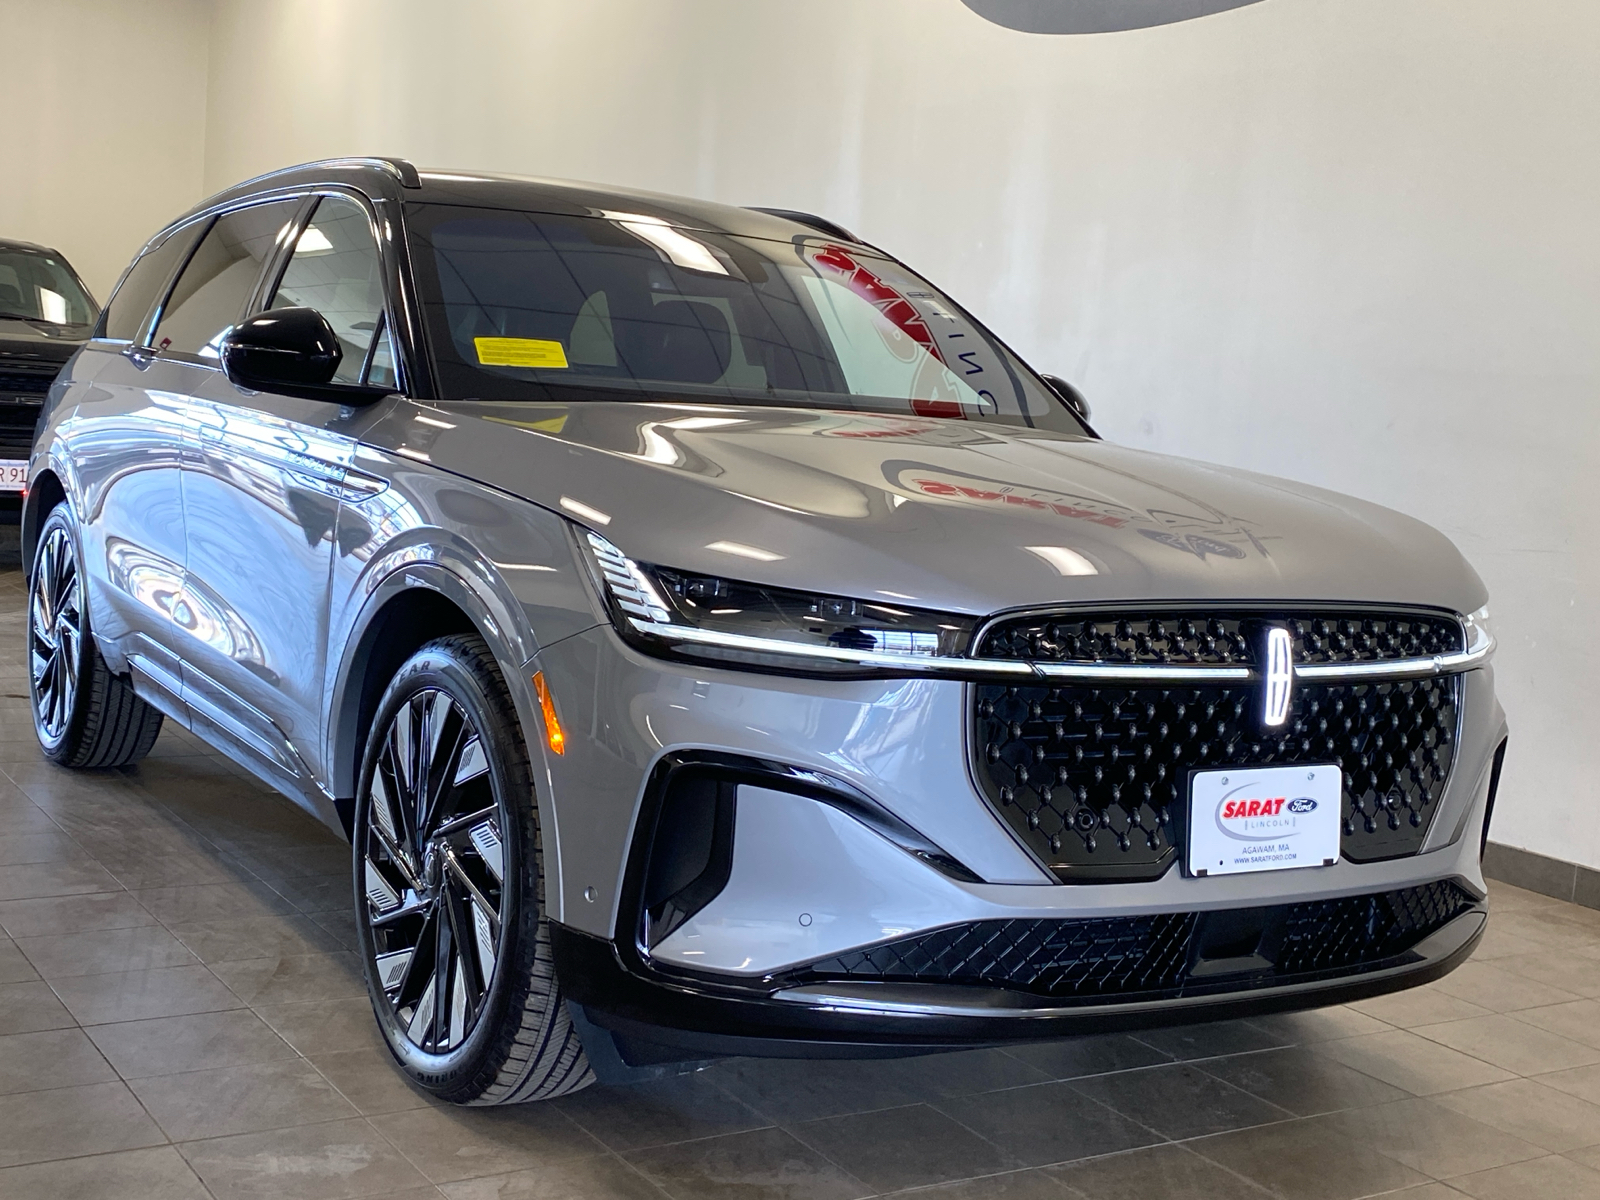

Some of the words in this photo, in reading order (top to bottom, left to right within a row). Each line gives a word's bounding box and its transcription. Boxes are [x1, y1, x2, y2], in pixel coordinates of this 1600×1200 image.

[1223, 798, 1286, 819] SARAT
[1291, 799, 1313, 812] Ford
[1251, 819, 1290, 829] LINCOLN
[1242, 845, 1276, 854] AGAWAM,
[1278, 844, 1290, 852] MA
[1234, 853, 1297, 864] WWW.SARATFORD.COM
